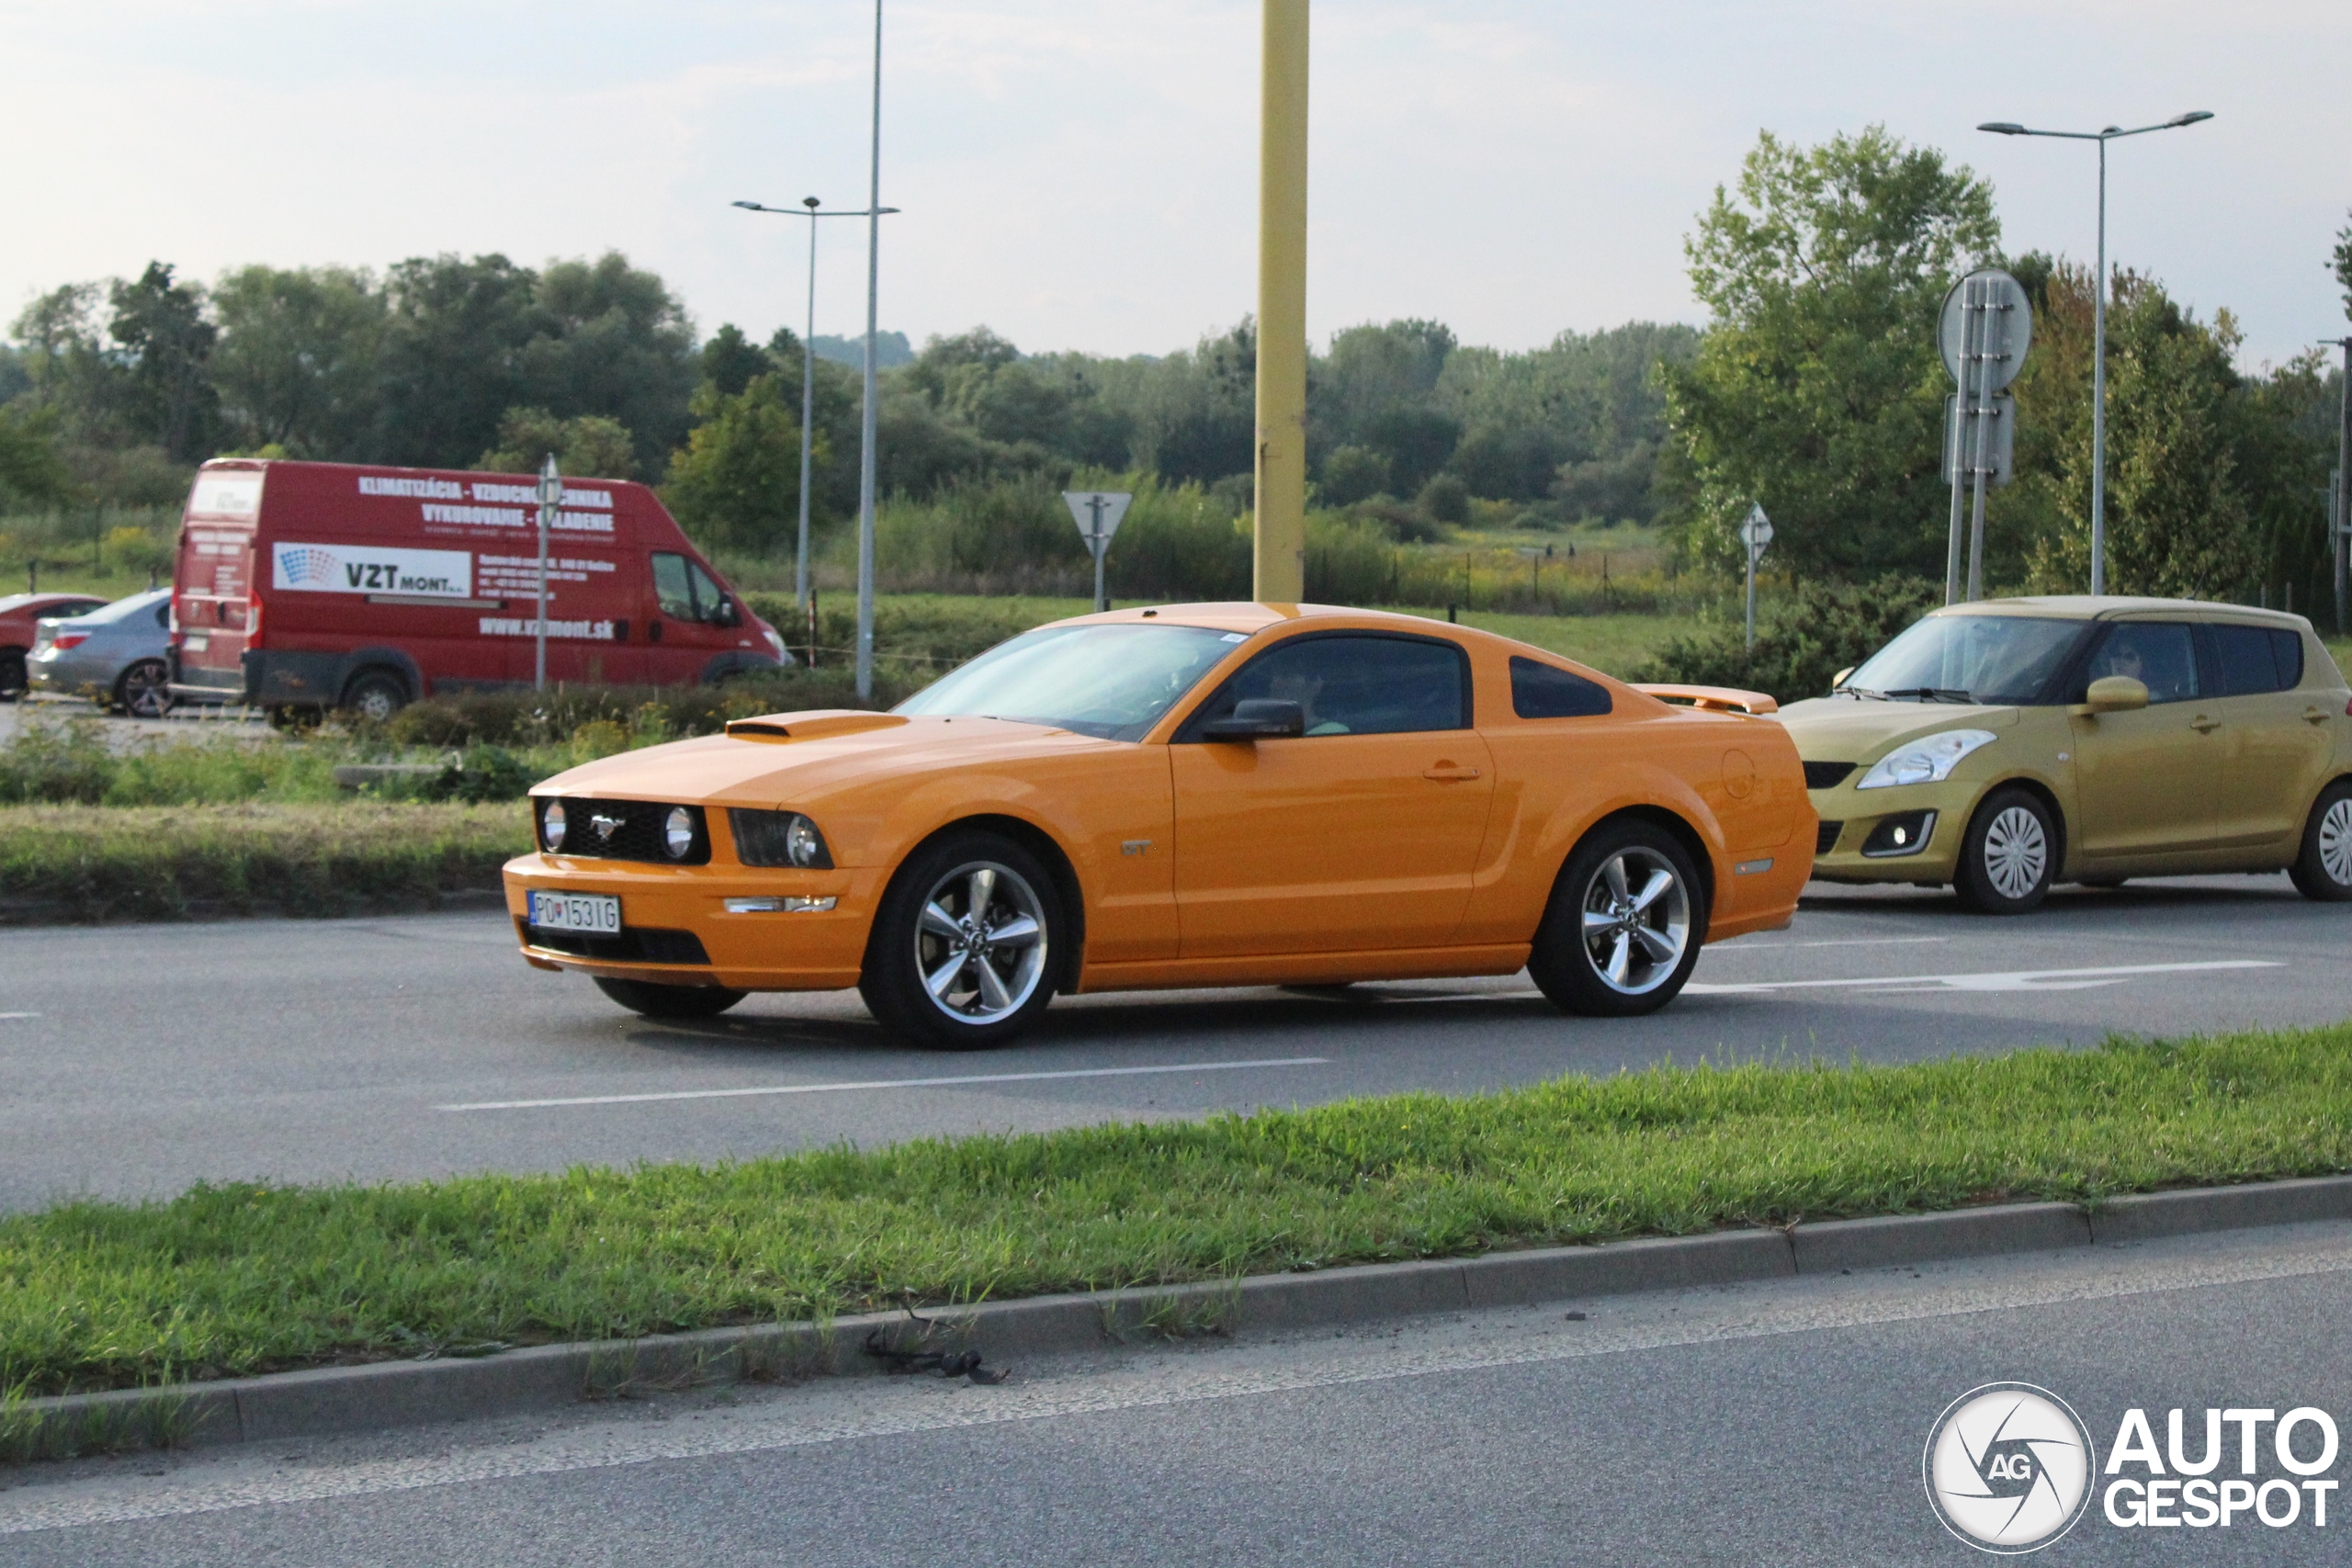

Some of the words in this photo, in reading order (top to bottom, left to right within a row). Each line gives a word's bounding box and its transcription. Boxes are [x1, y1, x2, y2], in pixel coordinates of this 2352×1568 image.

[471, 483, 614, 508] VZDUCHOCHNIKA
[422, 503, 526, 527] VYKUROVANIE
[535, 509, 614, 531] CLADENIE
[345, 563, 398, 589] VZT
[401, 577, 449, 591] MONT
[480, 617, 614, 639] www.vzmont.sk
[1122, 840, 1152, 855] GT
